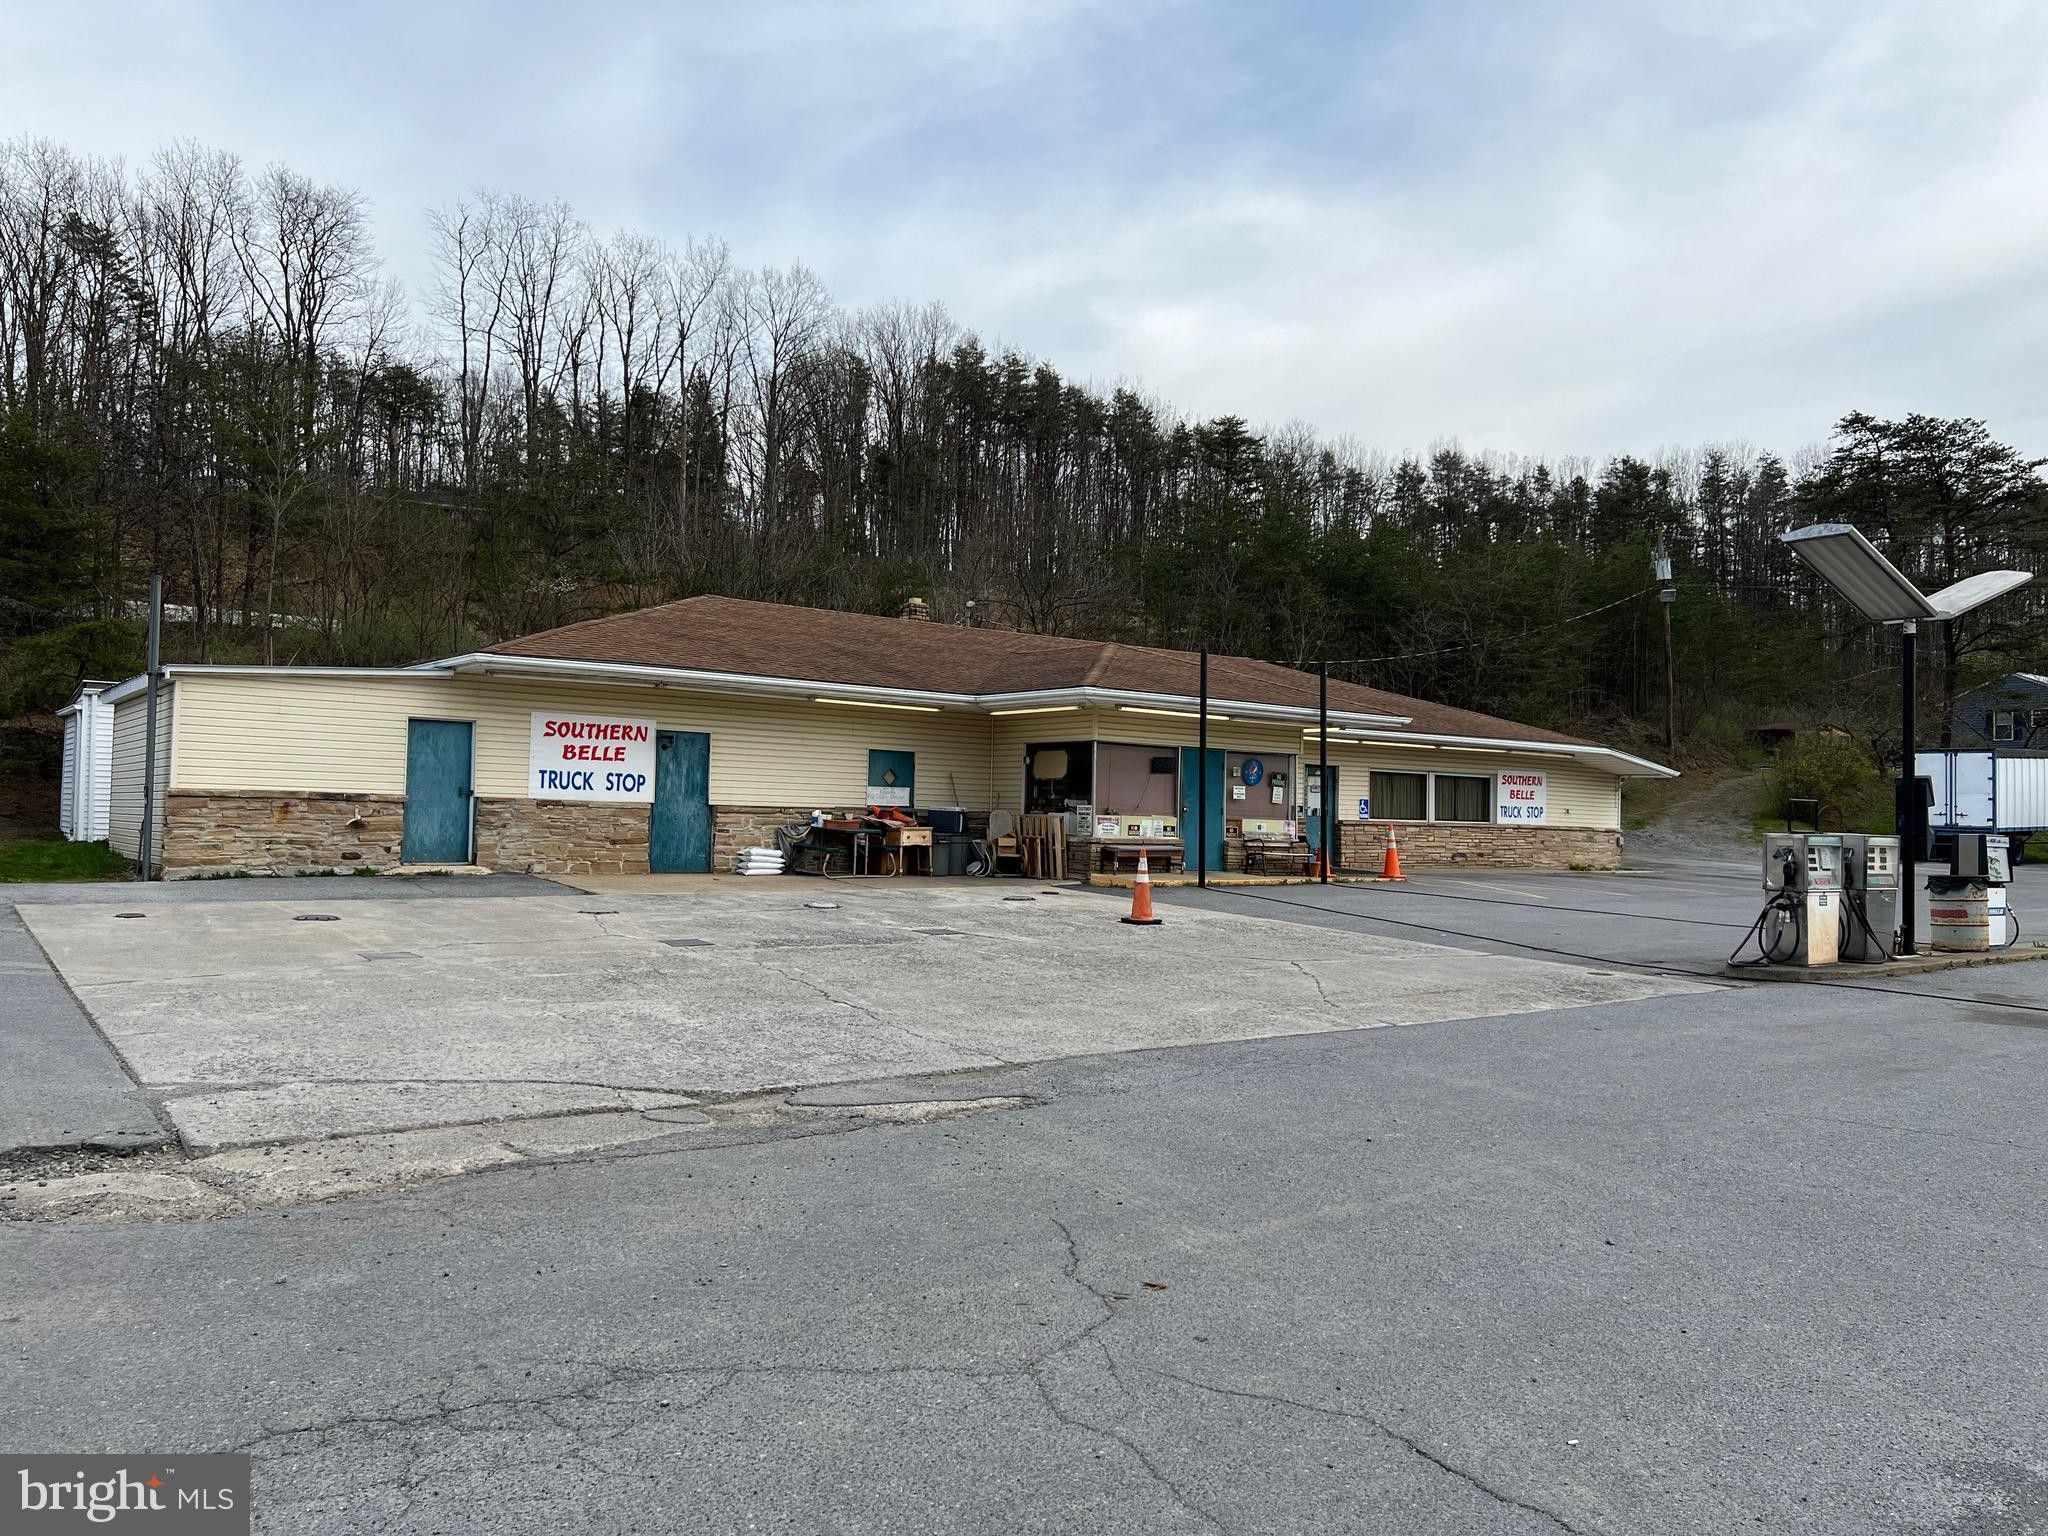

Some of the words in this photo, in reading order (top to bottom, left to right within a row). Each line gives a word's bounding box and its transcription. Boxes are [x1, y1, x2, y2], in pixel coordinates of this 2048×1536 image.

[543, 720, 648, 742] SOUTHERN
[562, 744, 627, 762] BELLE
[539, 769, 594, 791] TRUCK
[605, 772, 646, 792] STOP
[1501, 774, 1543, 786] SOUTHERN
[1509, 789, 1535, 800] BELLE
[1500, 805, 1522, 818] TRUCK
[1526, 806, 1544, 818] STOP
